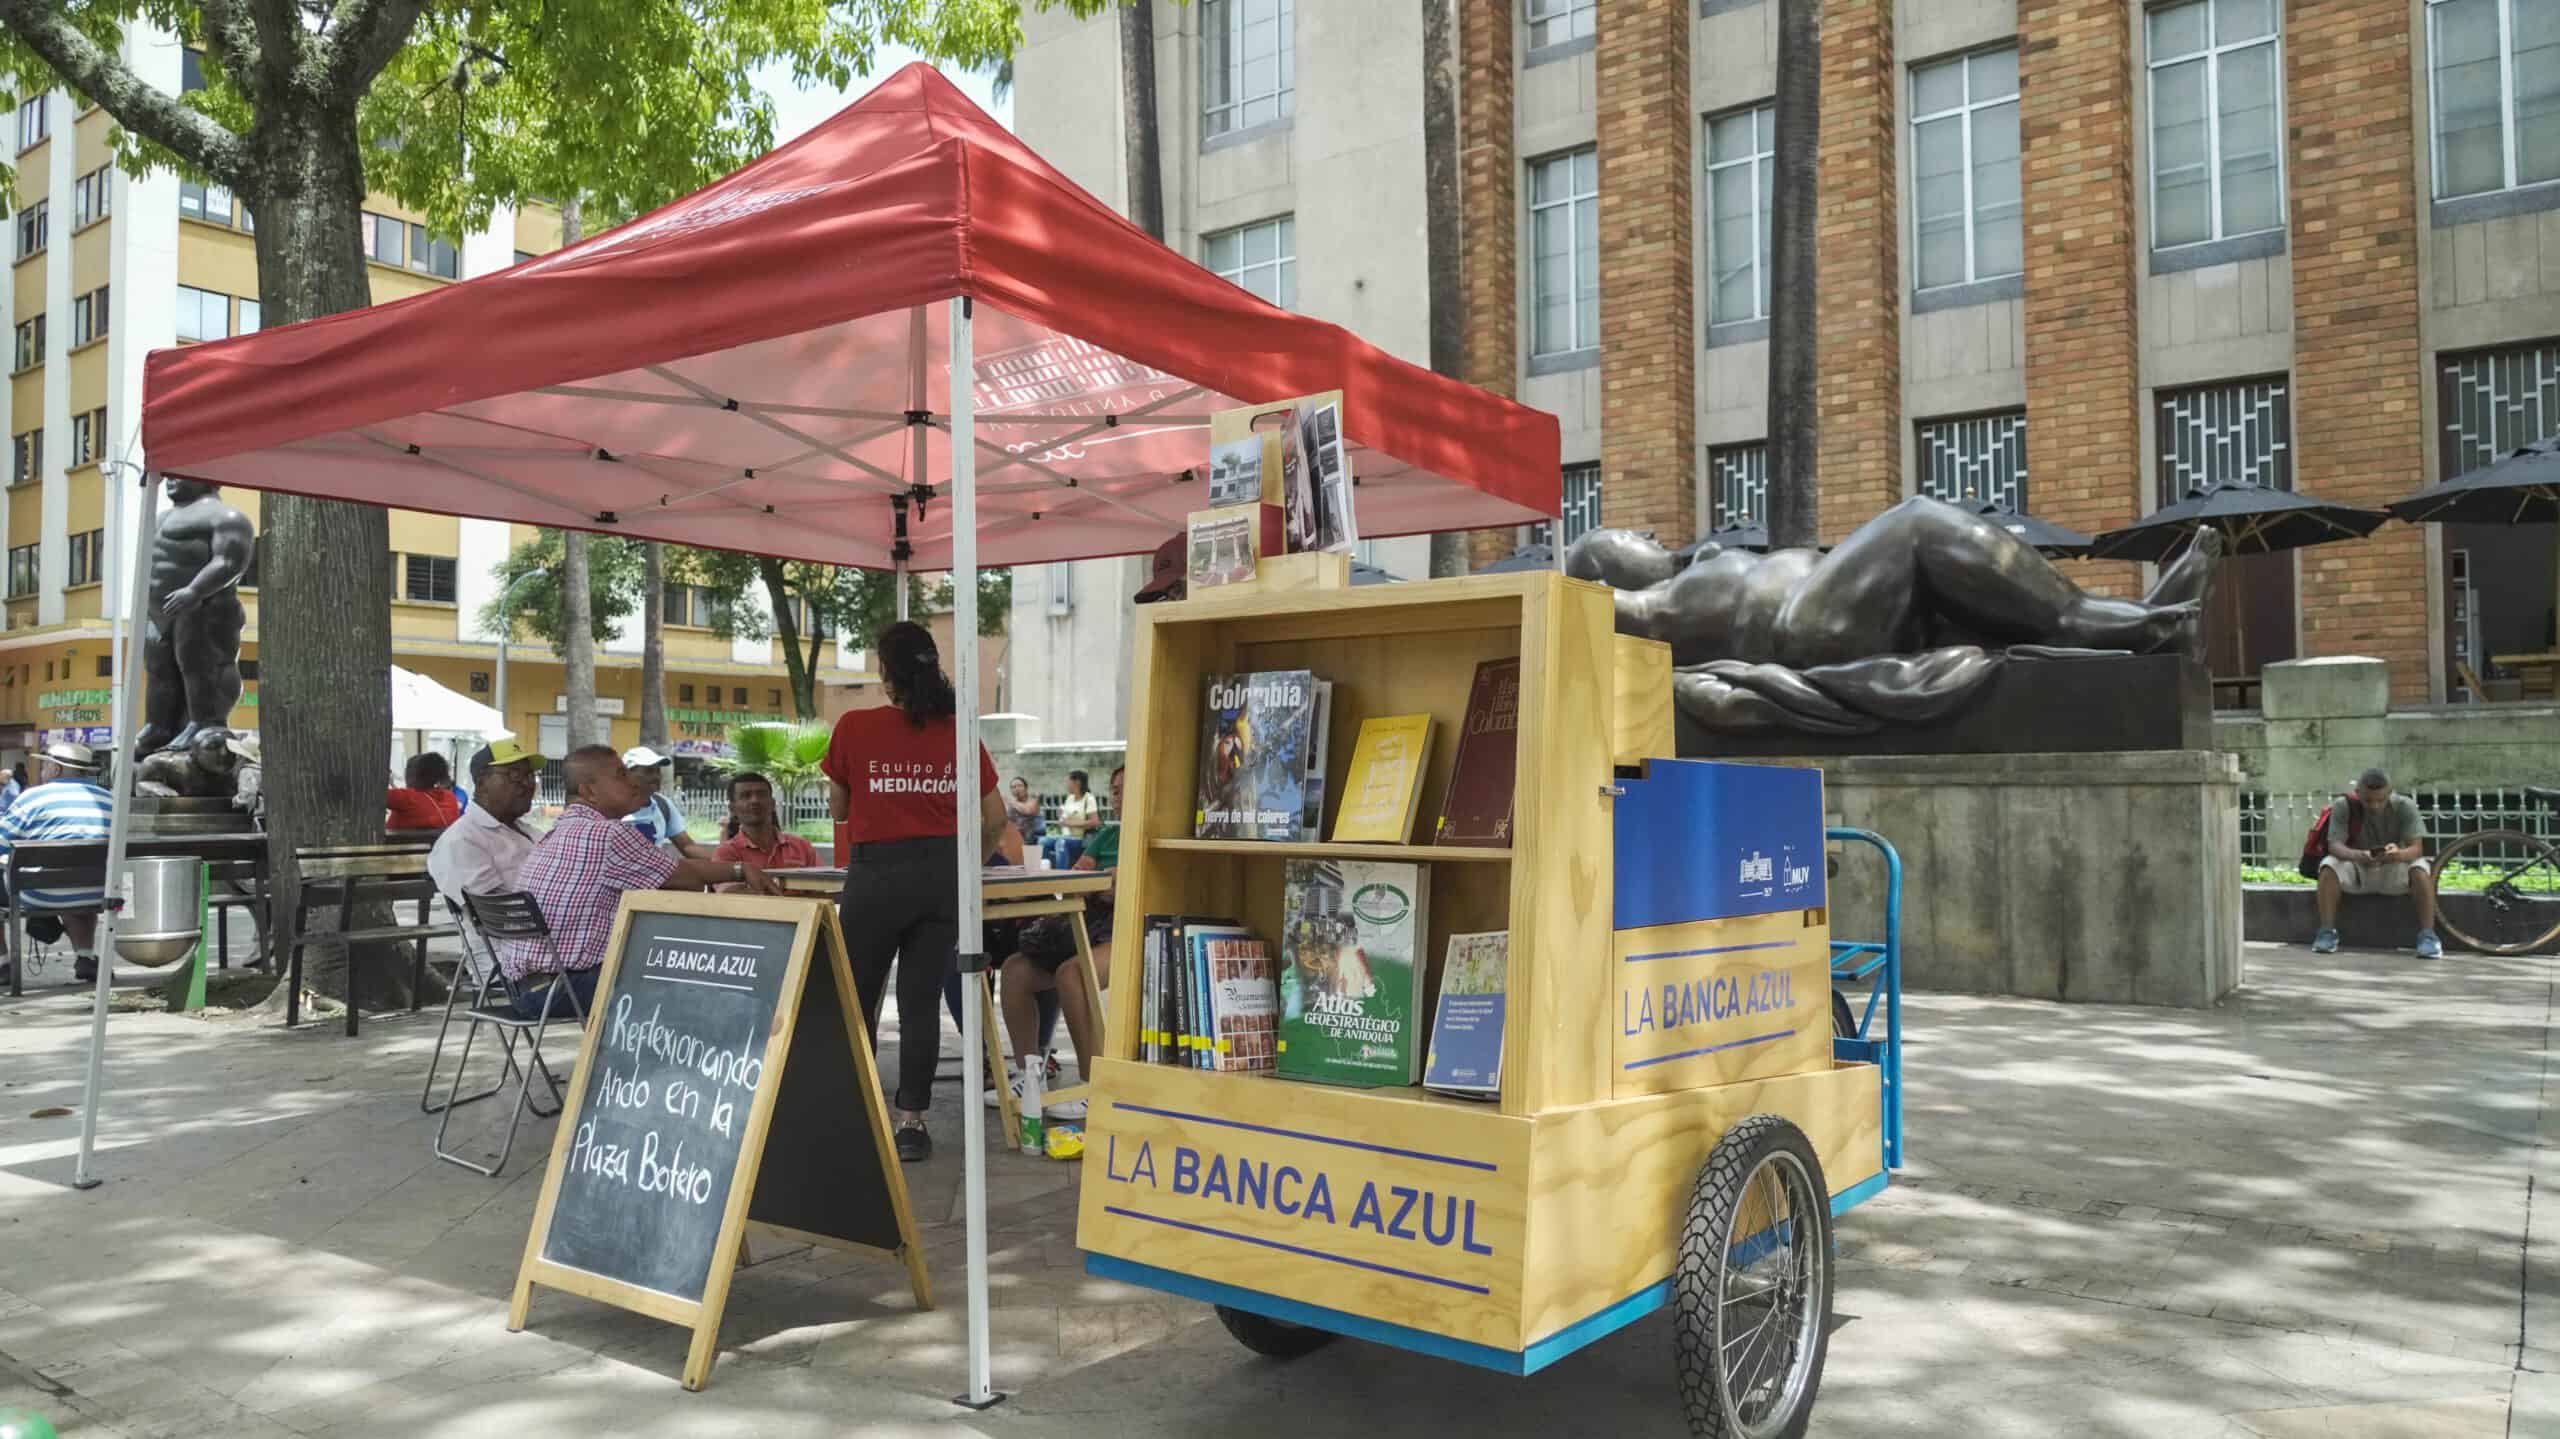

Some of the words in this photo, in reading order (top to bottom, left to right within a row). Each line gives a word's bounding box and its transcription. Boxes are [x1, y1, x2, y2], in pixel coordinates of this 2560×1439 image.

[1209, 681, 1302, 711] Colombia
[869, 760, 933, 775] Equipo
[944, 761, 957, 774] d
[646, 947, 664, 967] LA
[666, 949, 716, 973] BANCA
[717, 954, 758, 978] AZUL
[1312, 991, 1365, 1017] Atlas
[1624, 986, 1655, 1037] LA
[1662, 975, 1741, 1030] BANCA
[1745, 970, 1796, 1015] AZUL
[1304, 1012, 1401, 1033] GEOESTRATÉGICO
[1330, 1027, 1344, 1039] DE
[1344, 1029, 1394, 1043] ANTIOQUIA
[610, 993, 763, 1091] Reflexionando
[596, 1064, 650, 1109] Ando
[665, 1080, 700, 1119] en
[709, 1088, 734, 1139] la
[570, 1114, 630, 1185] Plaza
[638, 1131, 712, 1205] Botero
[1106, 1134, 1158, 1189] LA
[1172, 1146, 1336, 1224] BANCA
[1350, 1181, 1494, 1257] AZUL
